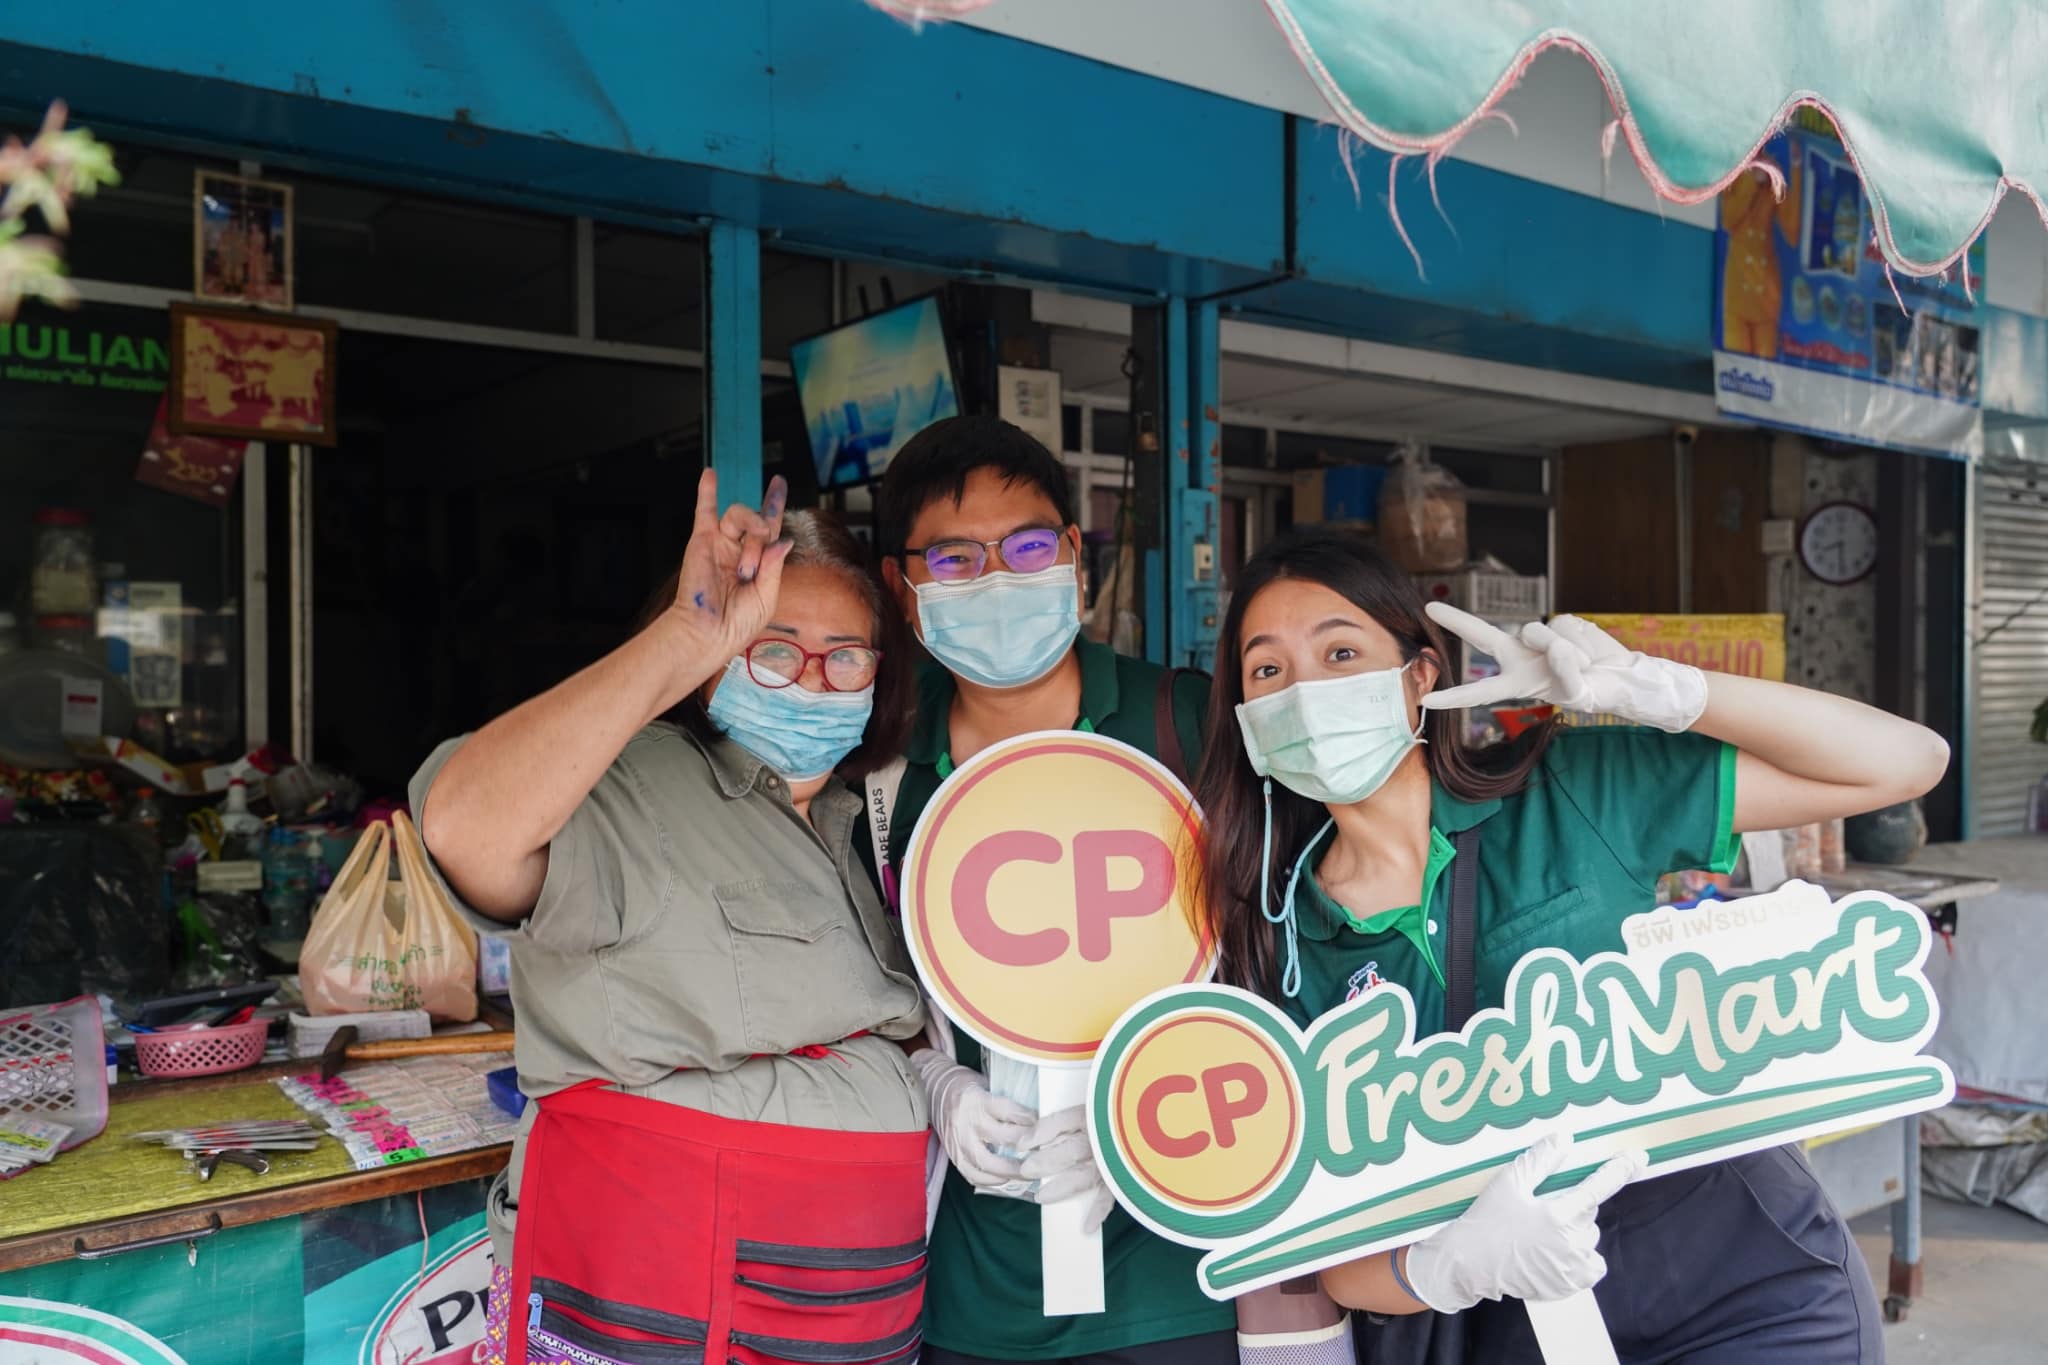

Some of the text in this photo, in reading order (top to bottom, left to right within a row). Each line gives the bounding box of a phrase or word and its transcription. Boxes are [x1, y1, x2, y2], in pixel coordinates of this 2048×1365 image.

[872, 788, 888, 832] BEARS
[951, 830, 1177, 967] CP
[1136, 1062, 1268, 1158] CP
